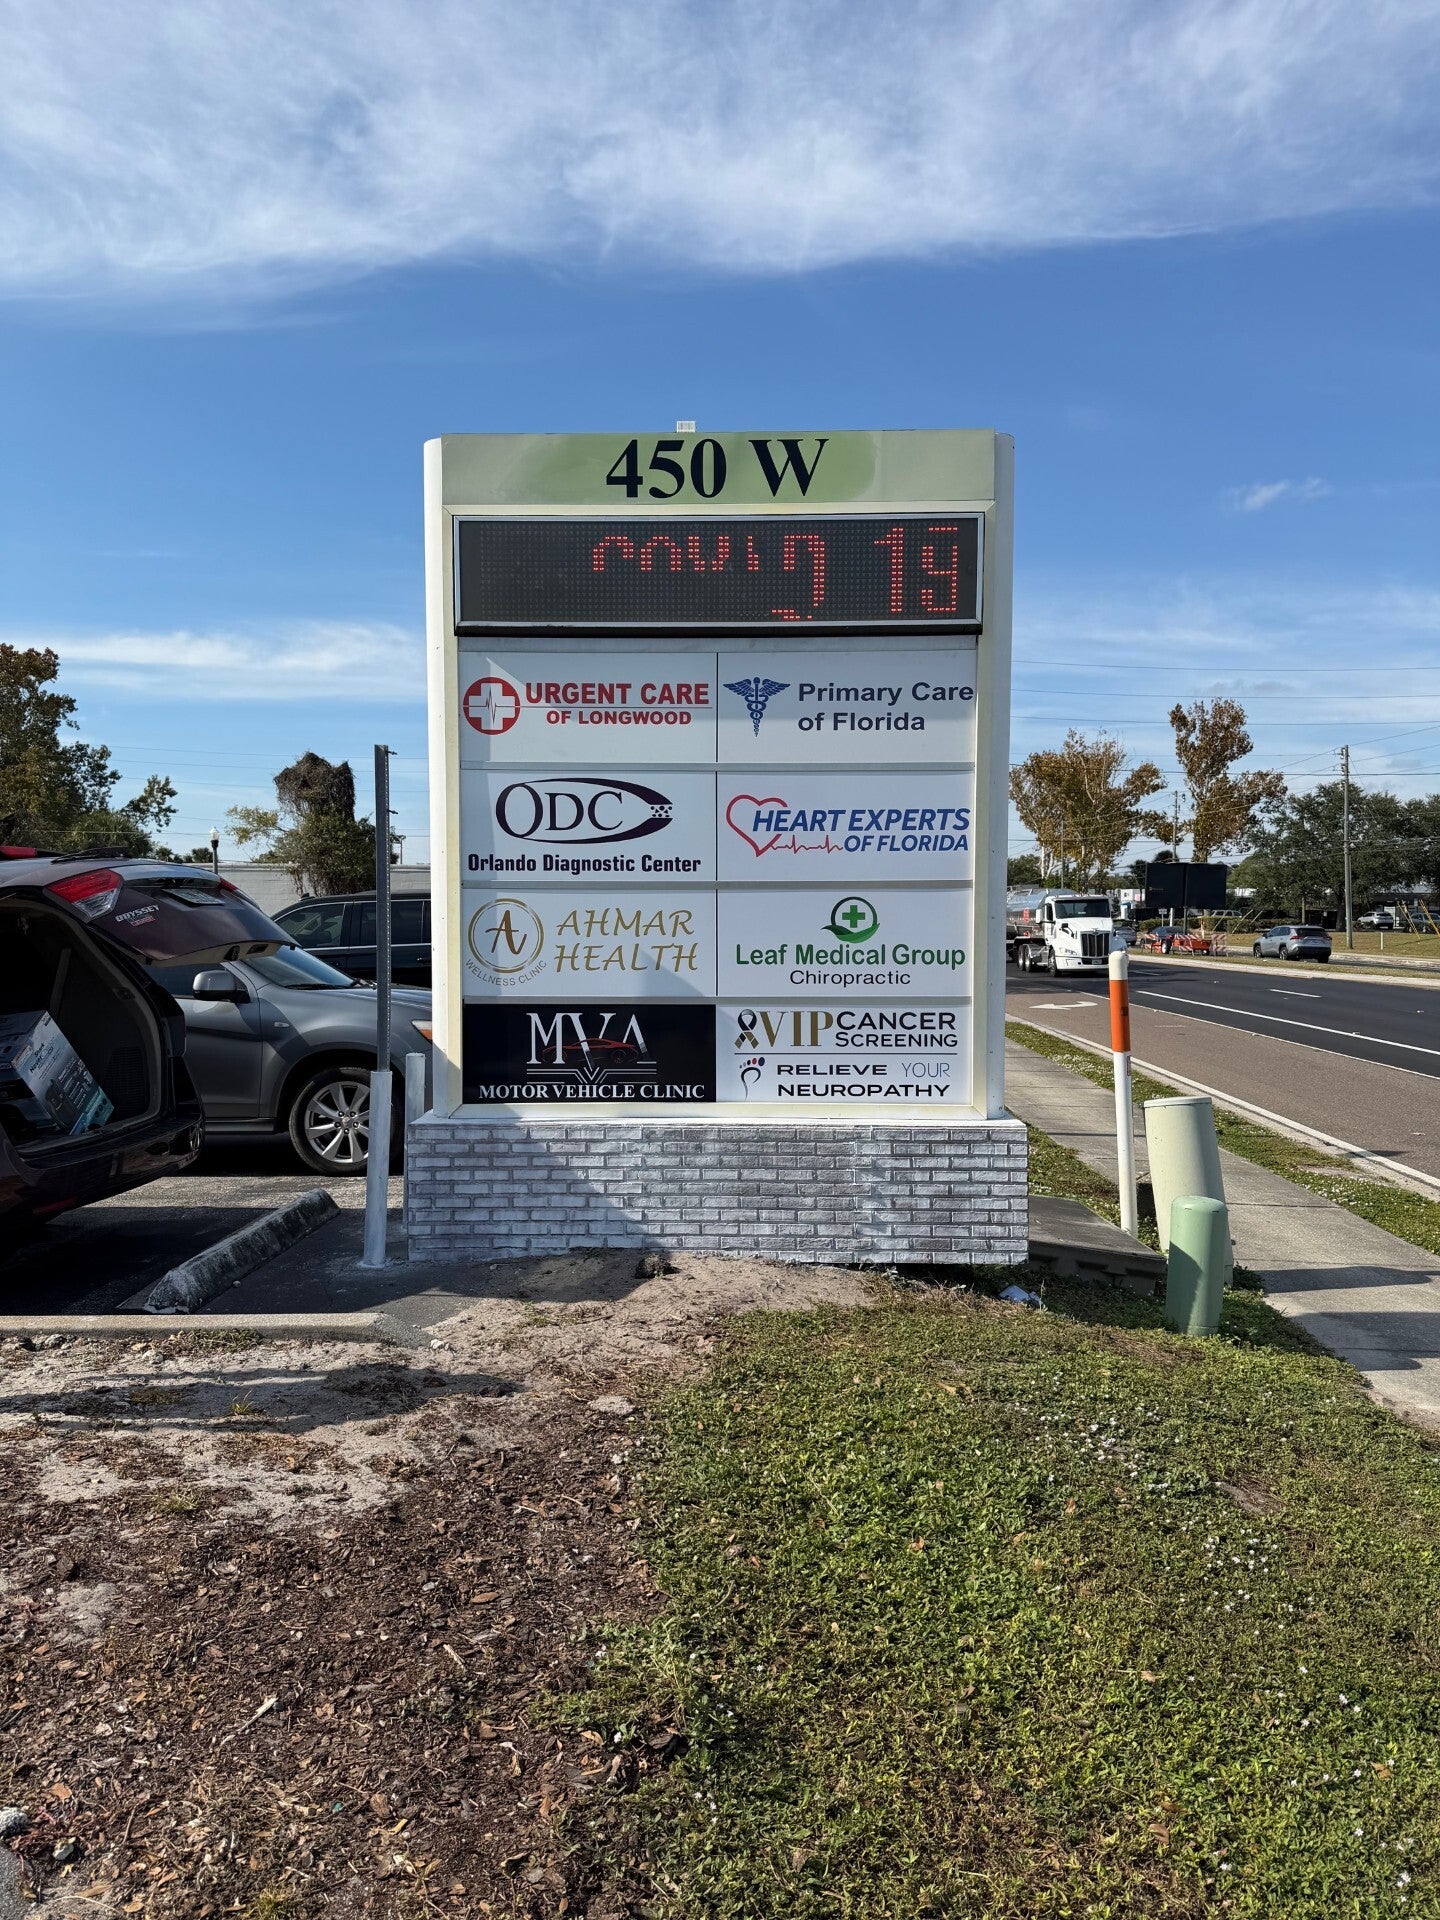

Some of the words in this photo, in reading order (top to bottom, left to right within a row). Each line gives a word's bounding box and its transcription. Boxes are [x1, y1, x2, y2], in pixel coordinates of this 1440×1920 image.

[606, 438, 728, 498] 450
[748, 438, 830, 497] W
[525, 682, 632, 705] URGENT
[640, 682, 710, 705] CARE
[798, 683, 902, 706] Primary
[911, 681, 974, 701] Care
[546, 710, 572, 725] OF
[578, 710, 692, 725] LONGWOOD
[798, 712, 825, 731] of
[833, 712, 925, 731] Florida
[495, 783, 623, 838] ODC
[752, 809, 846, 832] HEART
[847, 808, 970, 832] EXPERTS
[843, 835, 874, 852] OF
[877, 834, 969, 852] FLORIDA
[468, 853, 537, 872] Orlando
[543, 853, 635, 876] Diagnostic
[641, 854, 701, 872] Center
[115, 904, 160, 922] ODYSSEY
[556, 907, 695, 938] AHMAR
[554, 942, 698, 973] HEALTH
[736, 943, 788, 966] Leaf
[795, 943, 886, 966] Medical
[892, 943, 966, 971] Group
[465, 957, 517, 987] WELLNESS
[518, 959, 547, 985] CLINIC
[789, 970, 911, 988] Chiropractic
[526, 1012, 657, 1065] MVA
[756, 1010, 833, 1048] VIP
[836, 1011, 956, 1030] CANCER
[835, 1032, 958, 1048] SCREENING
[777, 1064, 887, 1076] RELIEVE
[901, 1062, 951, 1078] YOUR
[479, 1084, 549, 1099] MOTOR
[552, 1084, 635, 1099] VEHICLE
[640, 1084, 705, 1098] CLINIC
[778, 1084, 951, 1097] NEUROPATHY
